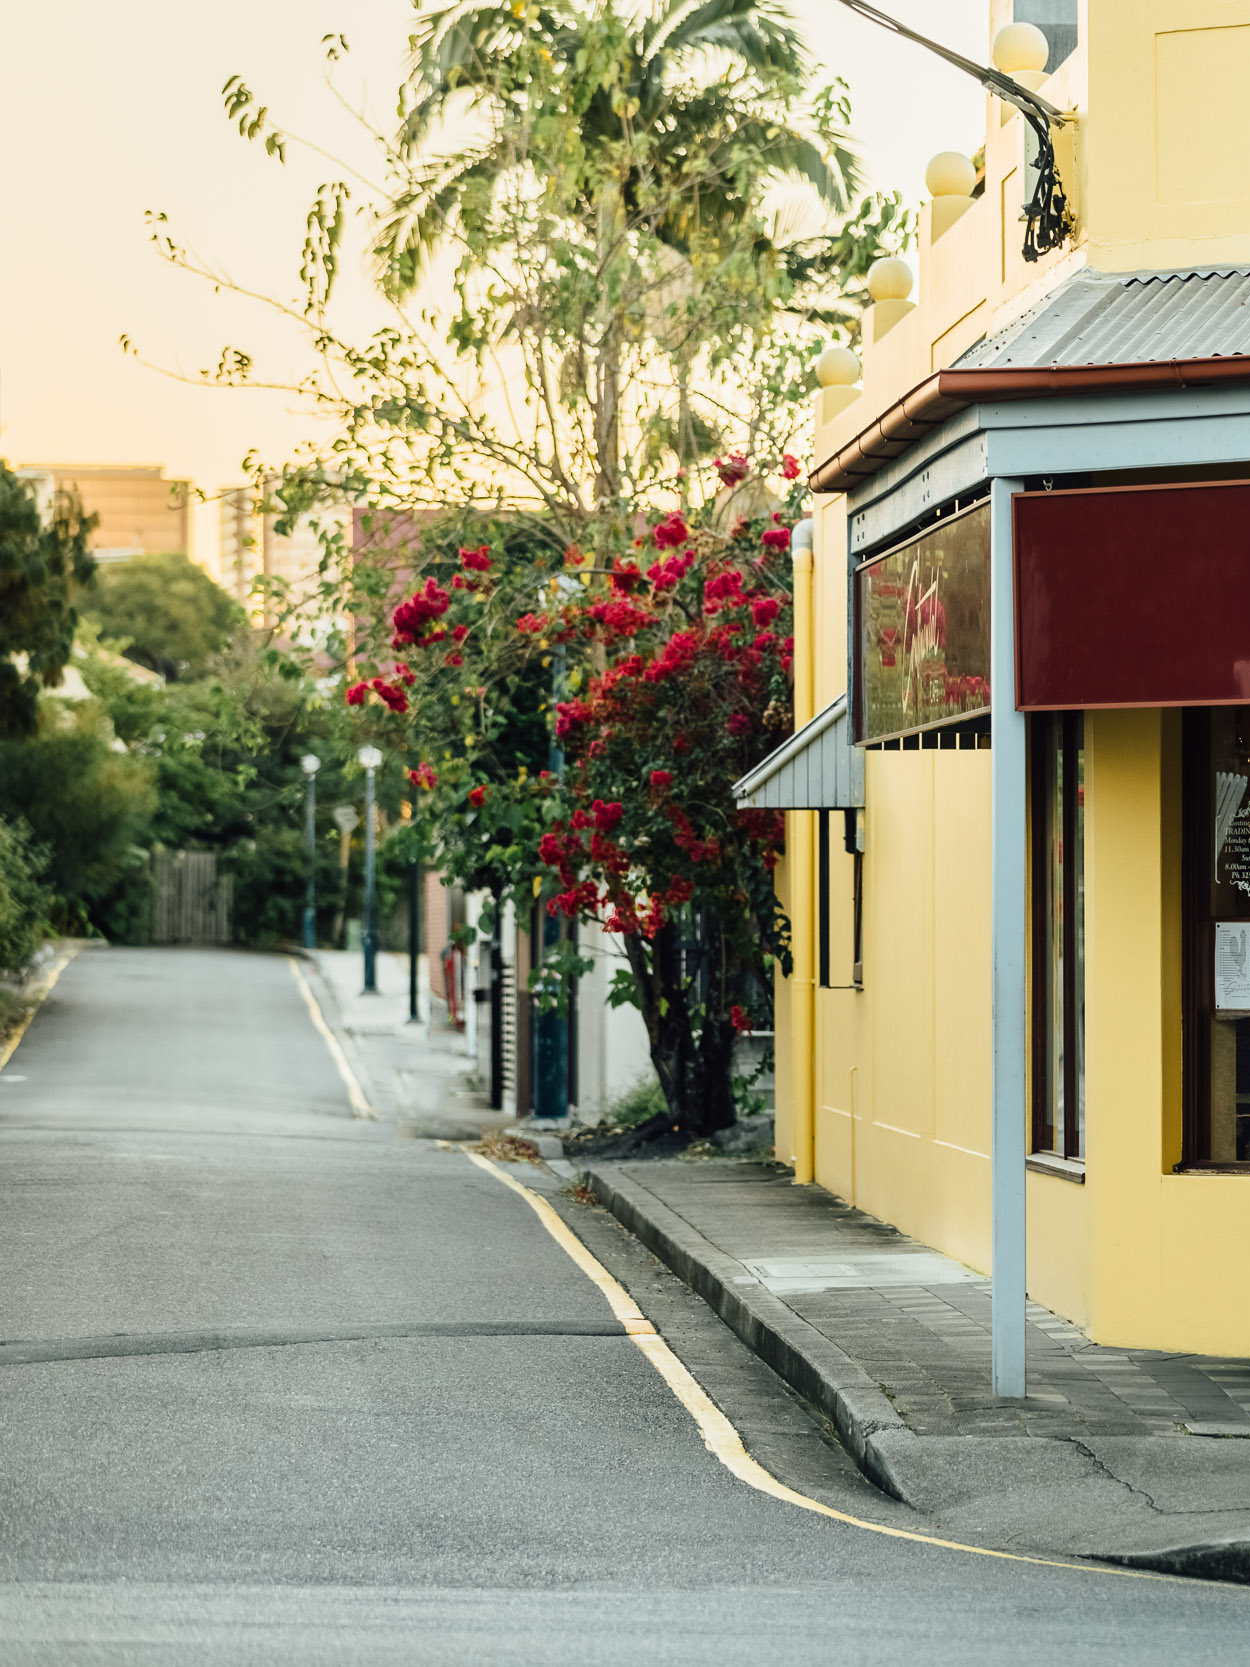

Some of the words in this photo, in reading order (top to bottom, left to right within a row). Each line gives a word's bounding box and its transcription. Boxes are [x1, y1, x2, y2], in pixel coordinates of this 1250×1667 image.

[1224, 836, 1247, 845] Monday
[1224, 845, 1250, 853] 11.30am
[1231, 871, 1240, 879] Ph
